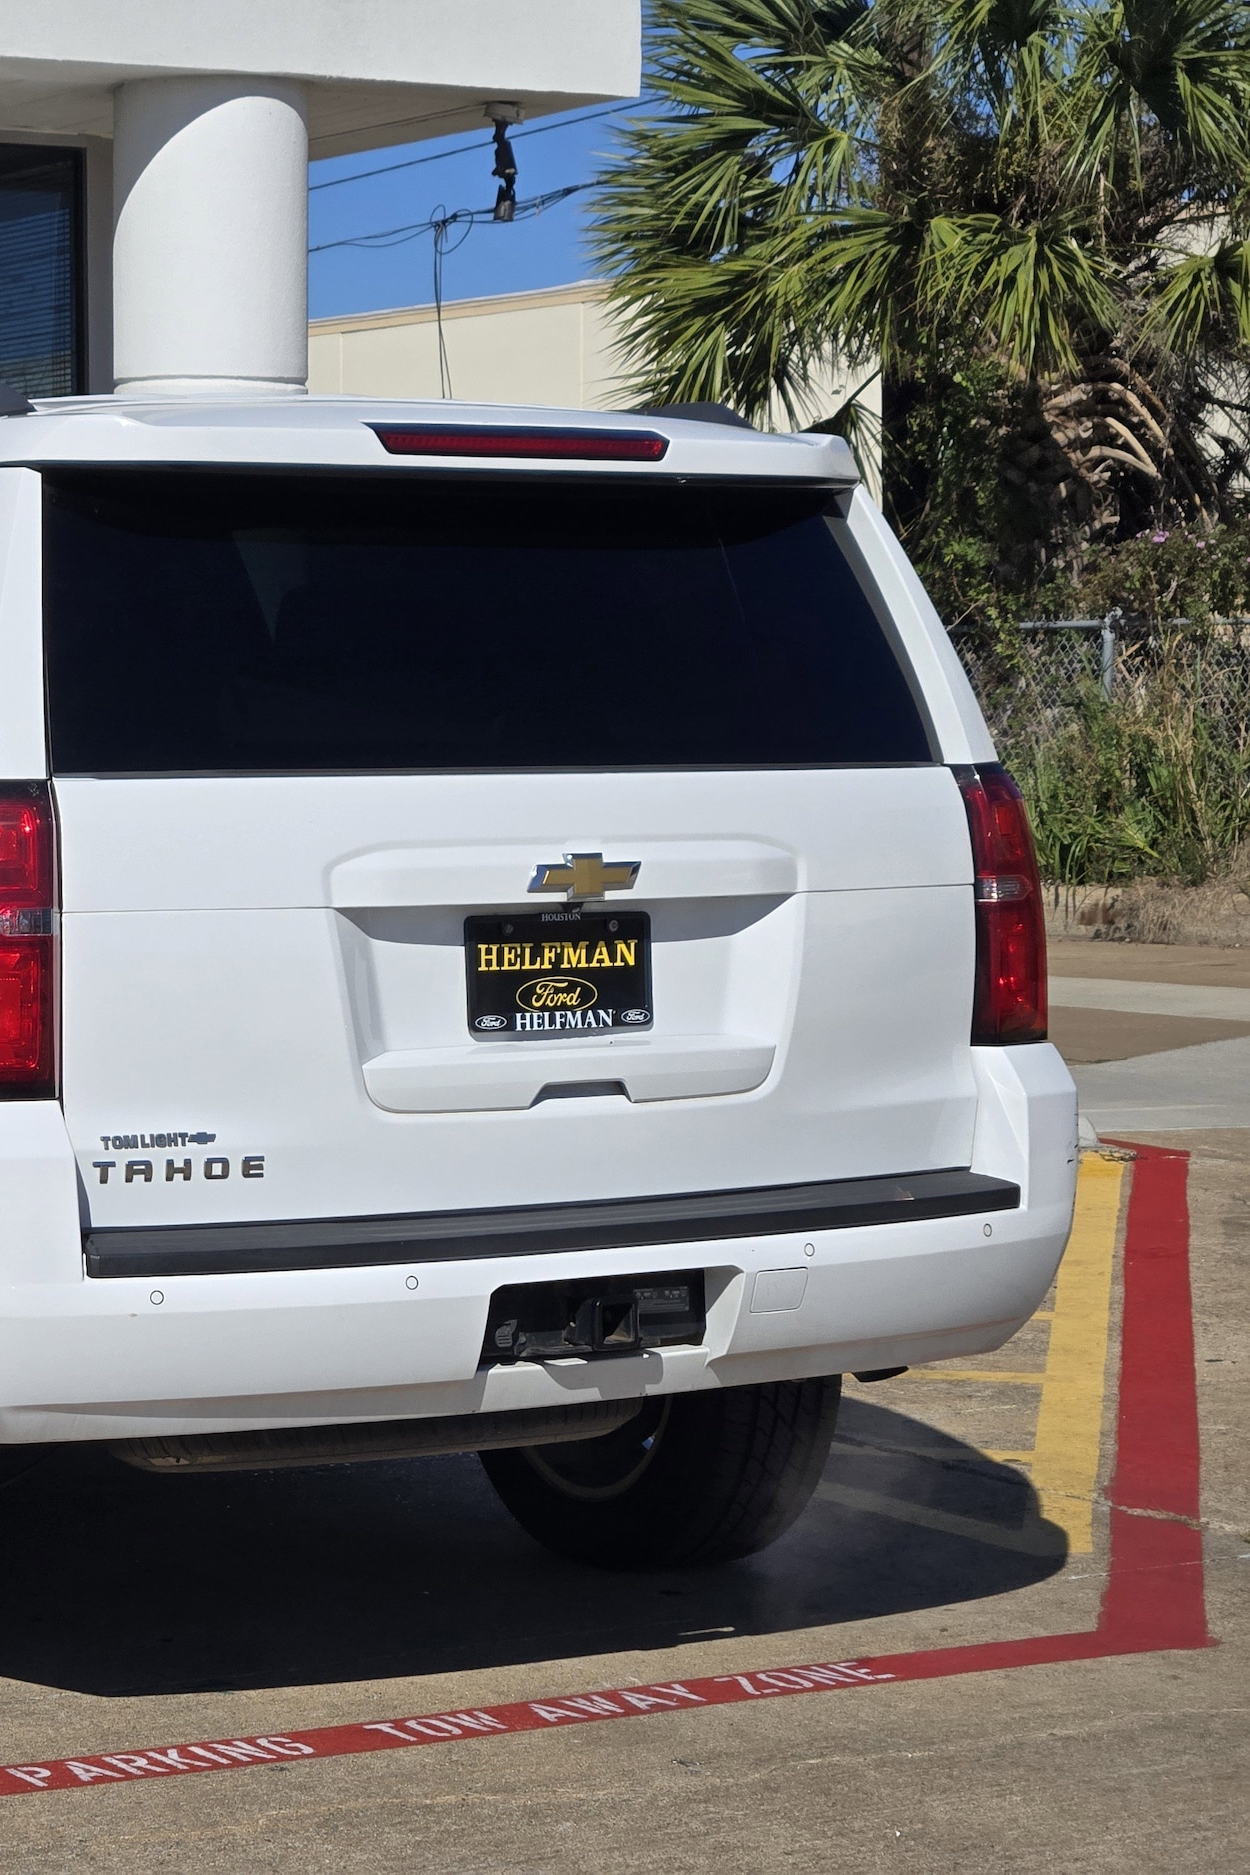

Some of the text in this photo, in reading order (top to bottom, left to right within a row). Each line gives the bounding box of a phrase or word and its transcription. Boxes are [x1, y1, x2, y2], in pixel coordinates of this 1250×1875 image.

[541, 912, 581, 922] HOUSTON
[477, 939, 638, 972] HELFMAN
[531, 981, 582, 1008] Ford
[515, 1009, 614, 1032] HELFMAN
[92, 1155, 265, 1185] TAHOE
[6, 1736, 315, 1788] PARKING
[363, 1710, 508, 1742] TOW
[528, 1683, 706, 1723] AWAY
[714, 1660, 895, 1696] ZONE
